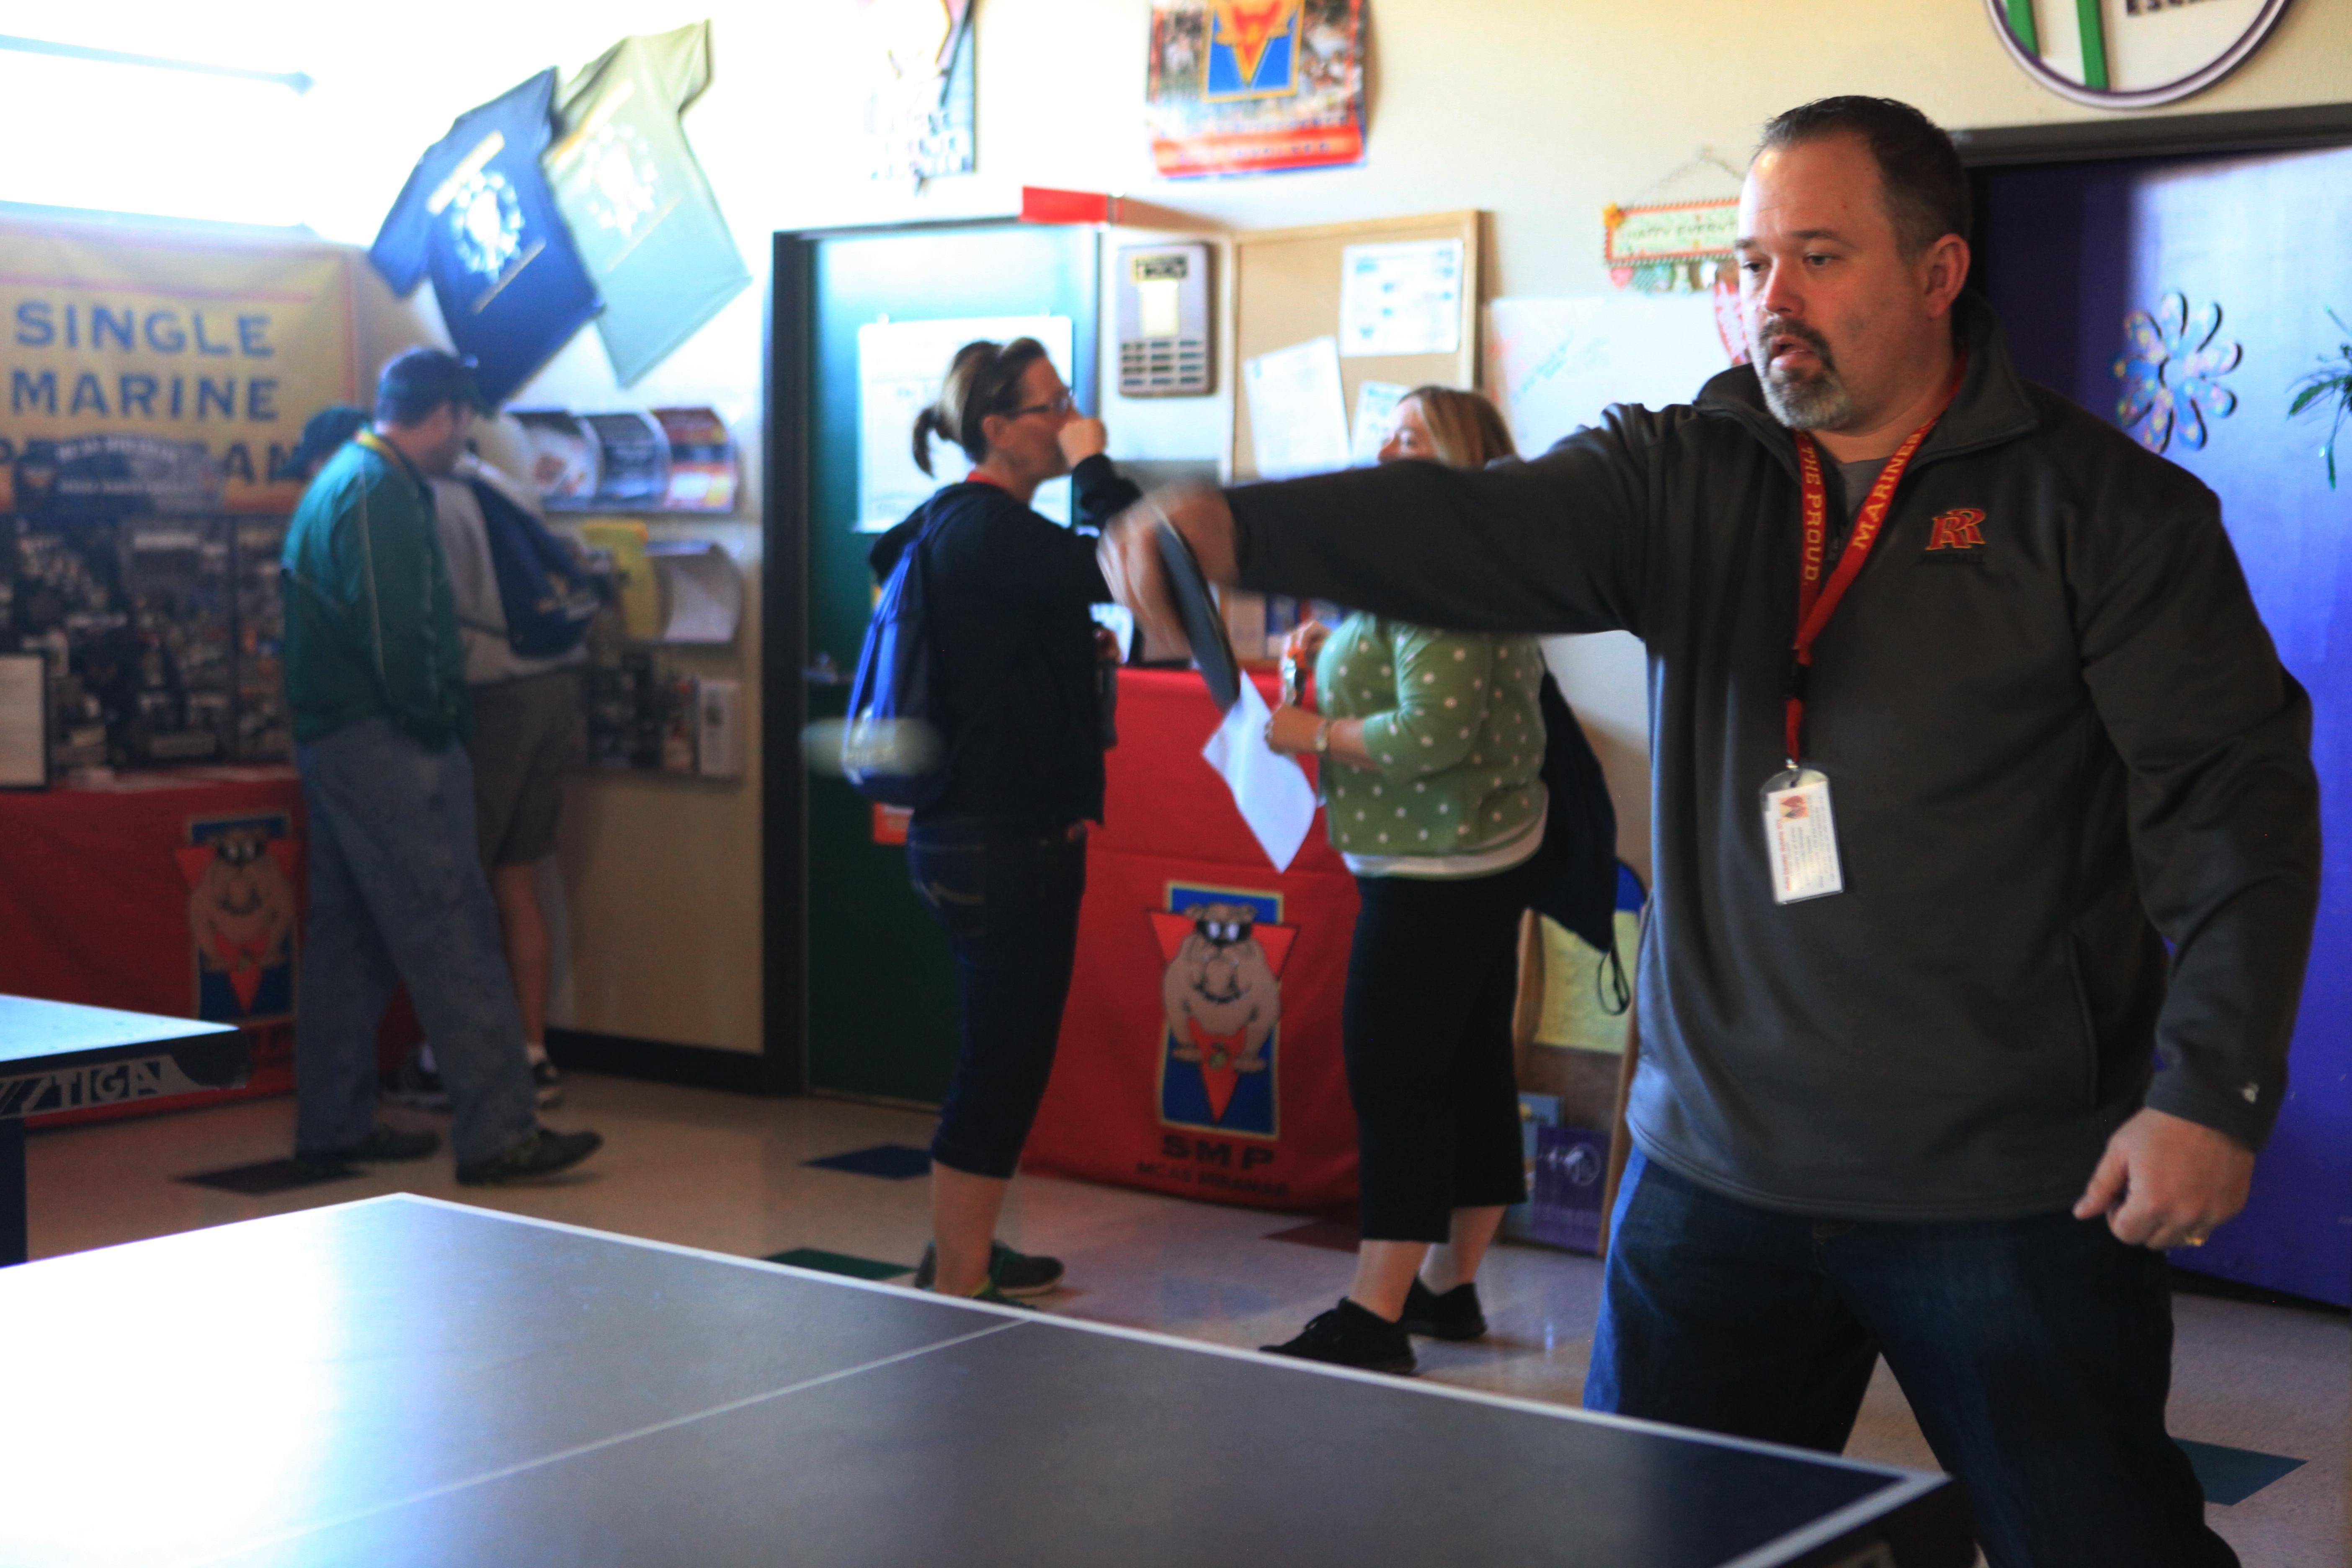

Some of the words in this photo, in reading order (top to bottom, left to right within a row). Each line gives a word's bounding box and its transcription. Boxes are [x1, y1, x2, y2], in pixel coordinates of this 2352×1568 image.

[15, 300, 274, 358] SINGLE
[12, 367, 281, 421] MARINE
[1800, 446, 1822, 486] THE
[1162, 1134, 1274, 1170] SMP
